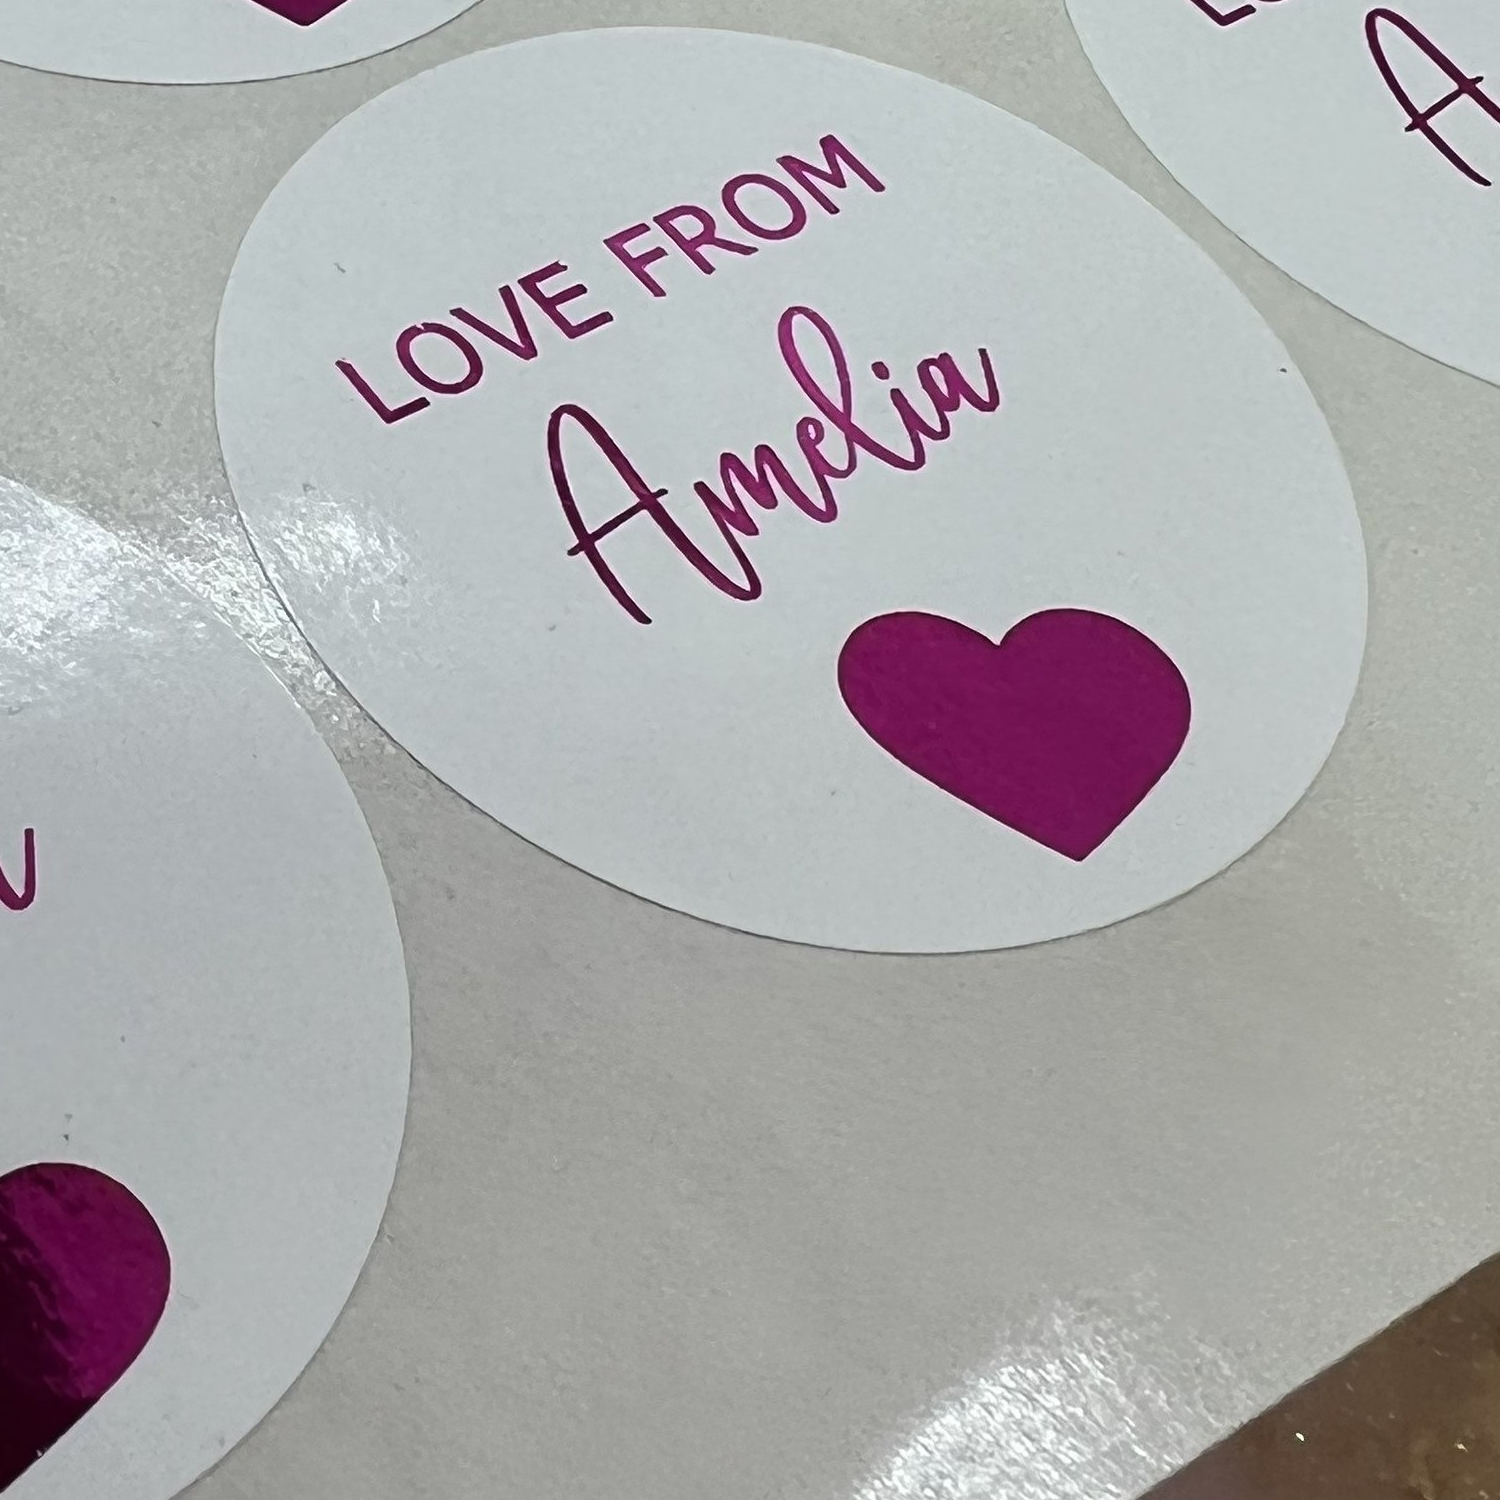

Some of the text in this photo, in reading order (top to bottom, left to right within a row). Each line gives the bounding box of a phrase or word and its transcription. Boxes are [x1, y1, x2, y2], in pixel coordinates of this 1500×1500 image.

[336, 134, 885, 425] LOVE FROM
[547, 306, 1000, 624] Amelia
